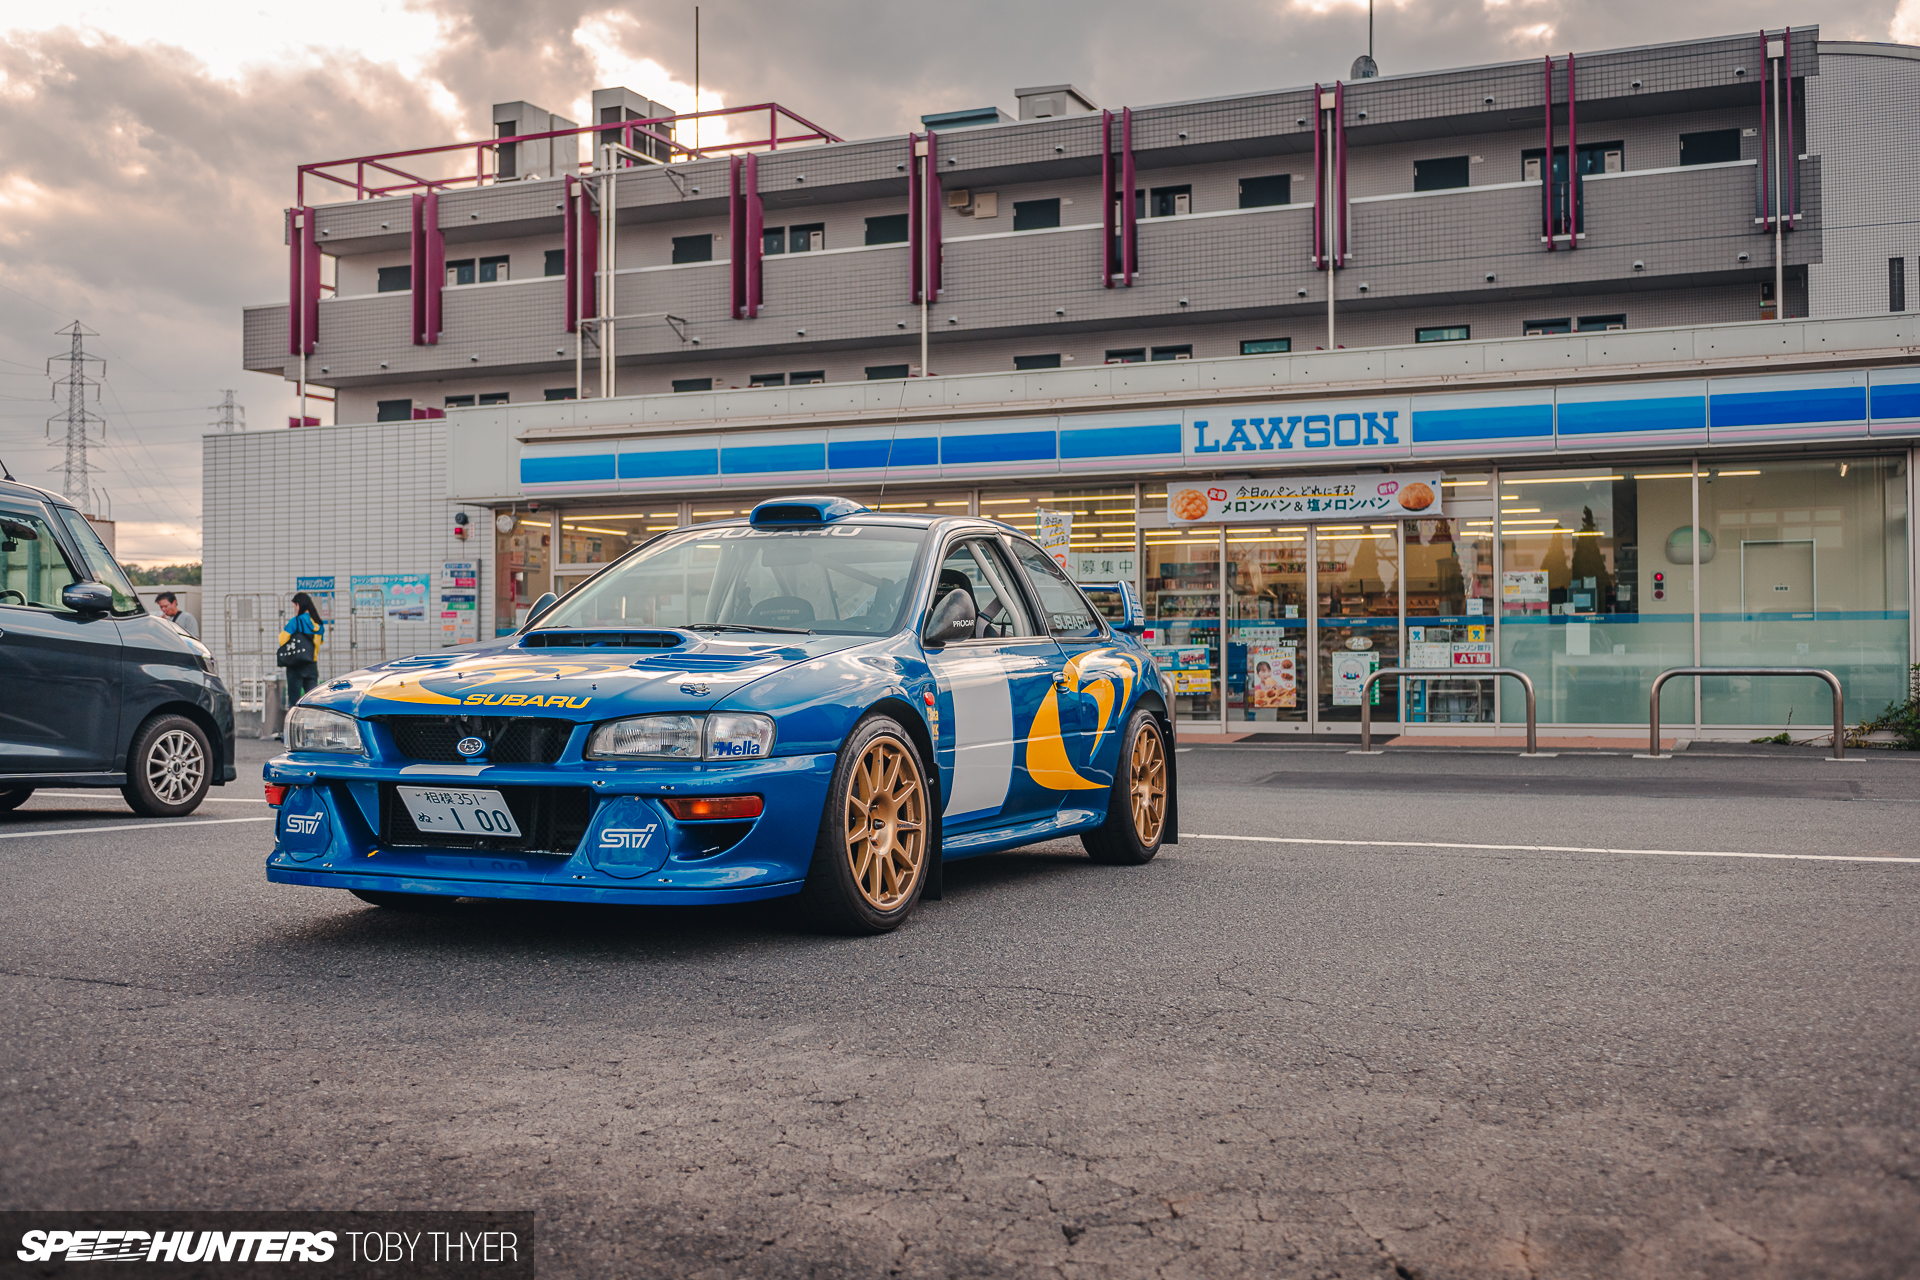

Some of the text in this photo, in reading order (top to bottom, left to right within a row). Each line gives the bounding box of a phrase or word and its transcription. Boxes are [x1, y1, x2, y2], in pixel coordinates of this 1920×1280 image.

[1194, 411, 1399, 453] LAWSON
[1222, 500, 1291, 514] メロンパン
[1307, 497, 1390, 512] 塩メロンパン
[697, 527, 863, 540] SUBARU
[1081, 559, 1133, 575] 募集中
[1053, 614, 1091, 630] SUBARU
[1459, 654, 1486, 663] ATM
[463, 693, 592, 709] SUBARU
[718, 741, 760, 756] Hella
